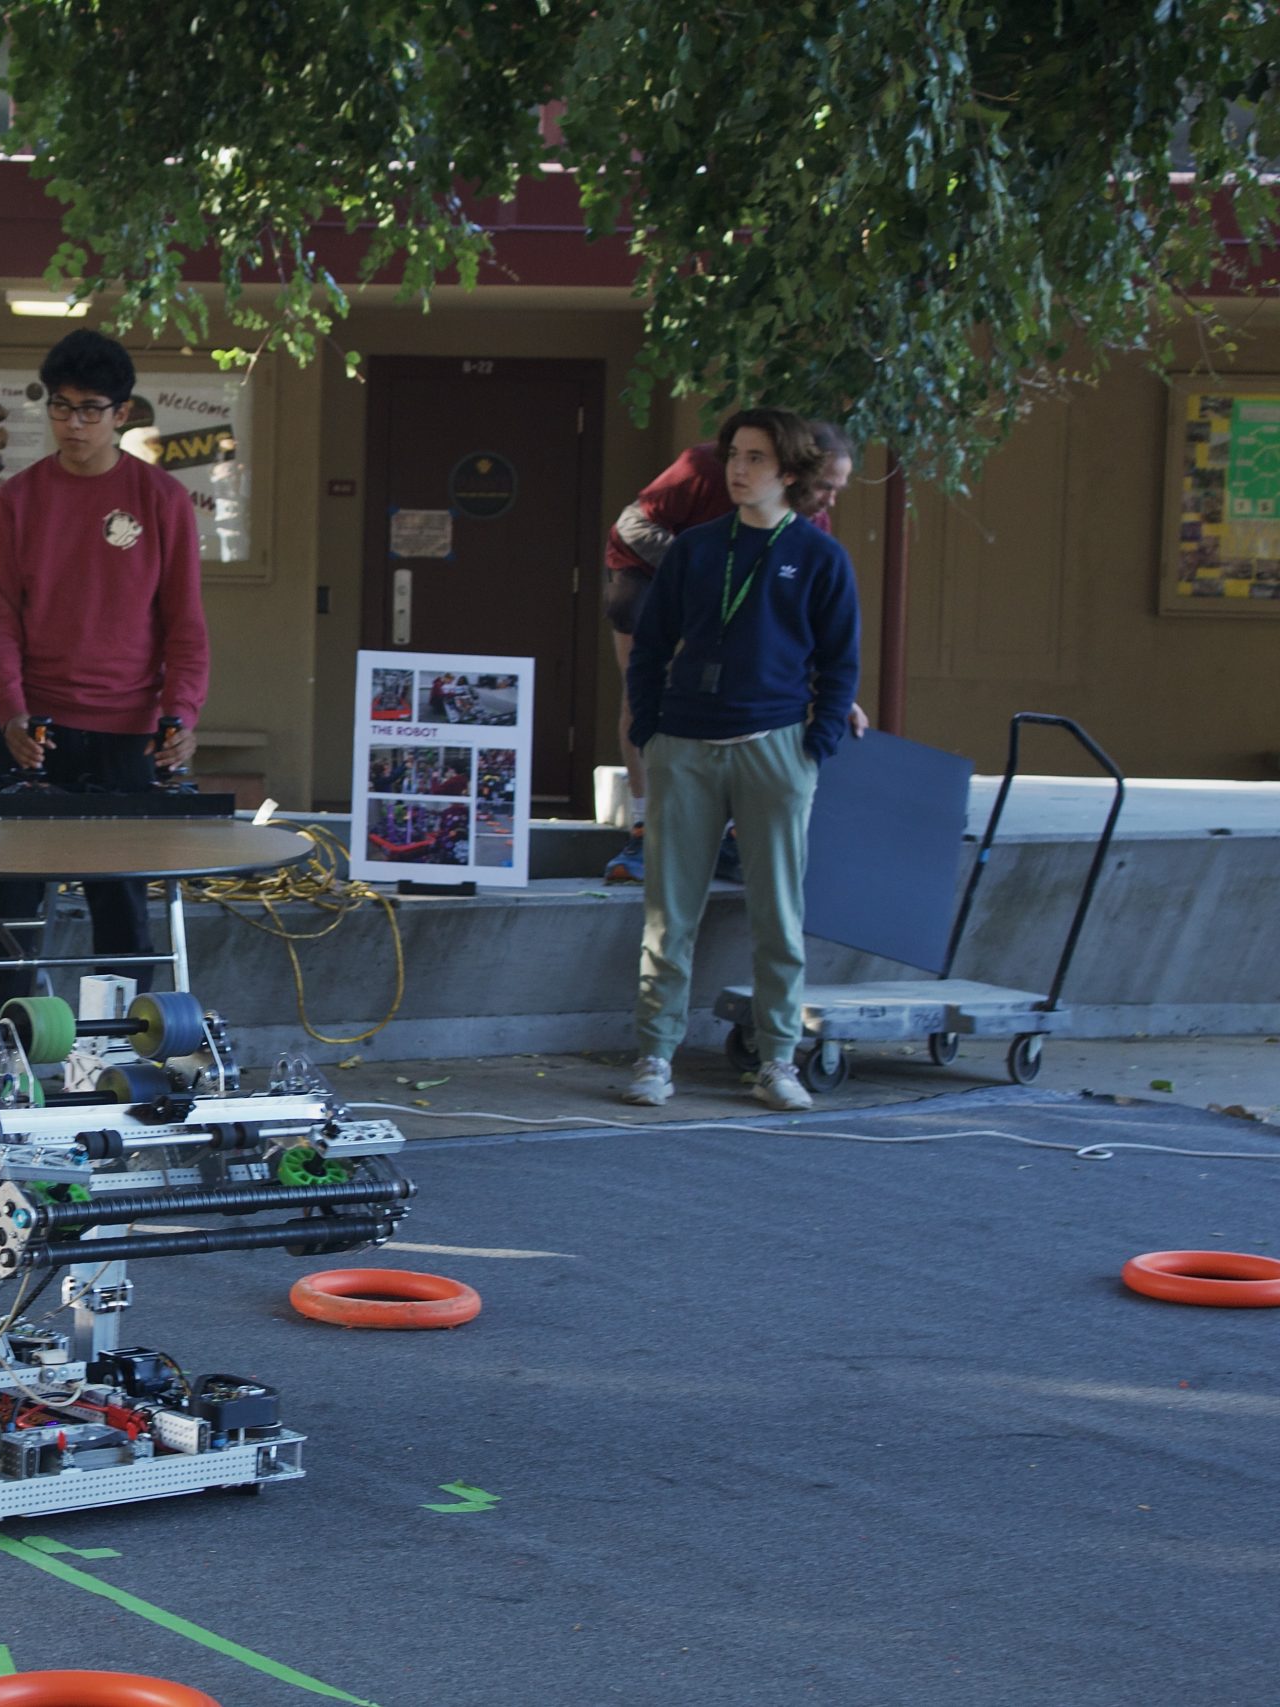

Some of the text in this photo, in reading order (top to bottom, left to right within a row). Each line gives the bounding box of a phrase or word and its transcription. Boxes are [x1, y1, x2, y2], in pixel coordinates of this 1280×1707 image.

[157, 391, 231, 419] Welcome
[371, 725, 439, 738] THE ROBOT
